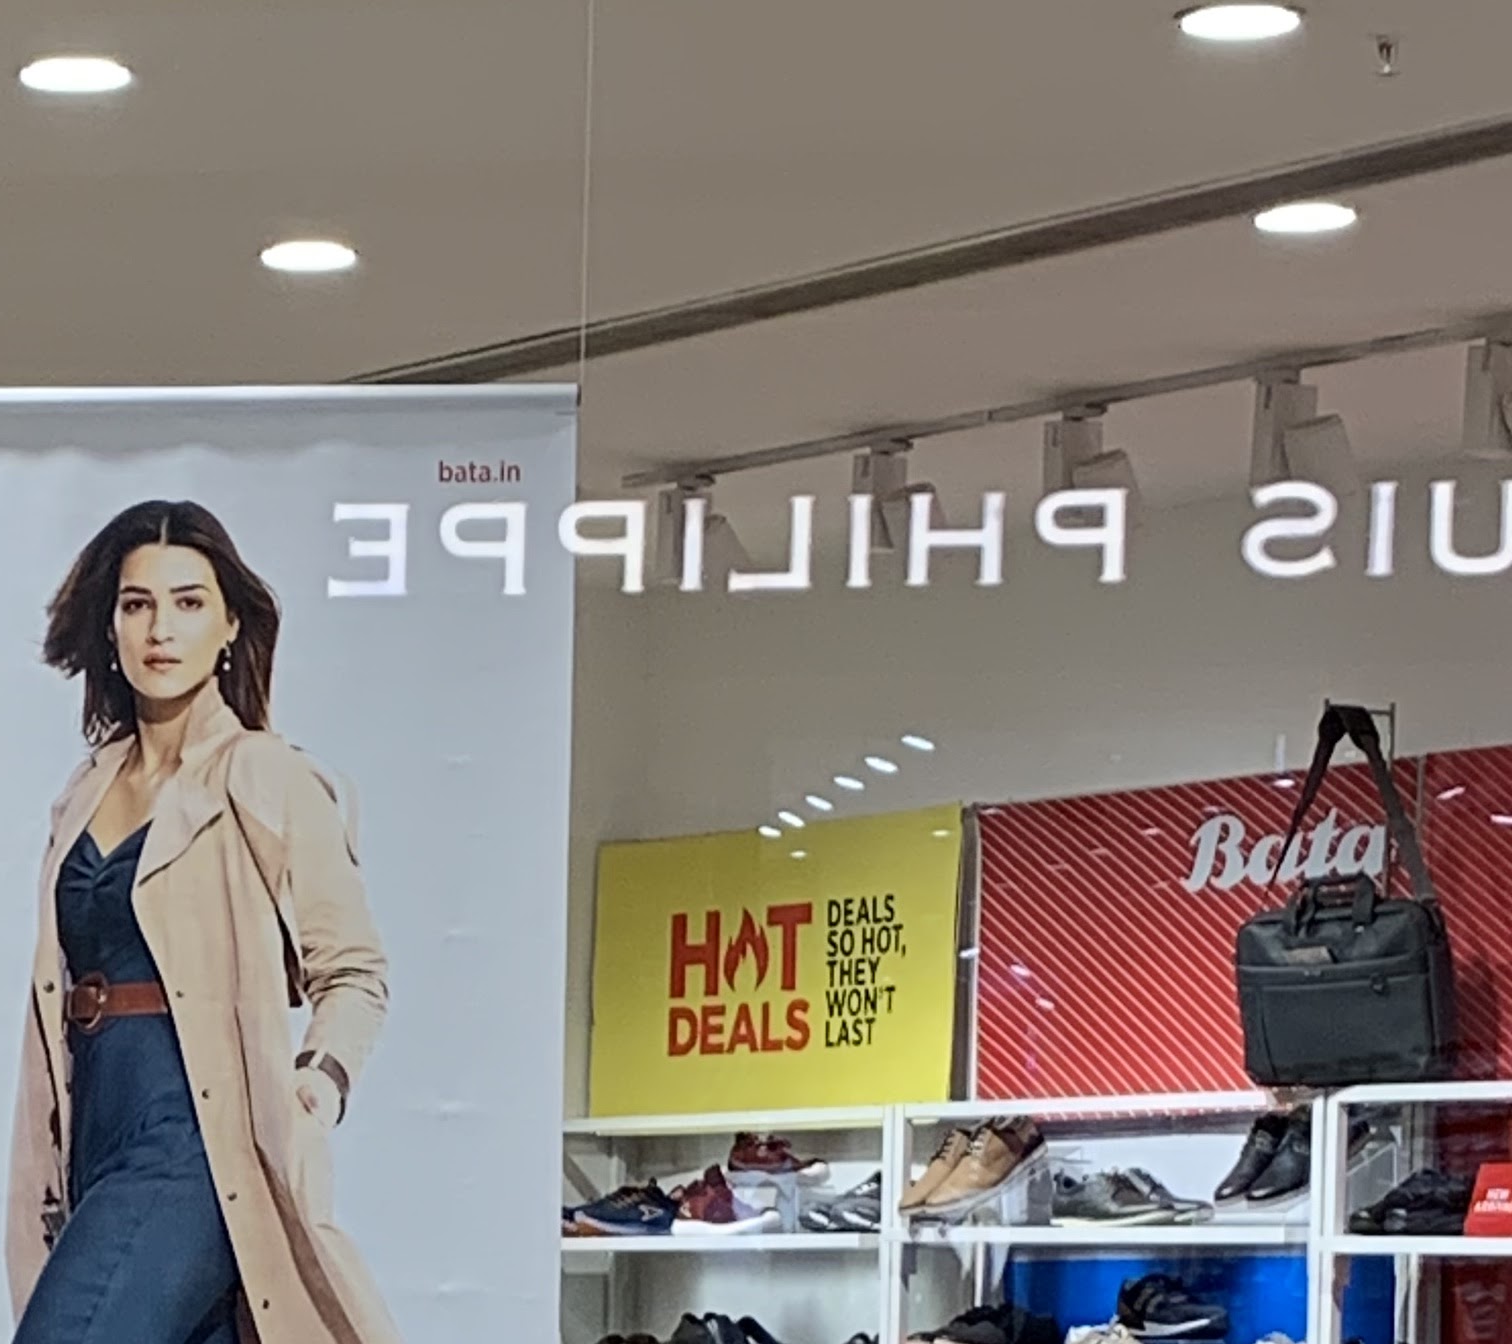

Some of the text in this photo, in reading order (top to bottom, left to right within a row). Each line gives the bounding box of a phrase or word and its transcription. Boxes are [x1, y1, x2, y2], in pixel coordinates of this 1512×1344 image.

[438, 459, 521, 483] bata.in
[1179, 806, 1392, 892] Bata
[827, 893, 896, 927] DEALS
[826, 923, 907, 958] SO HOT,
[826, 956, 881, 987] THEY
[825, 985, 896, 1018] WON'T
[667, 999, 811, 1057] DEALS
[824, 1017, 877, 1048] LAST
